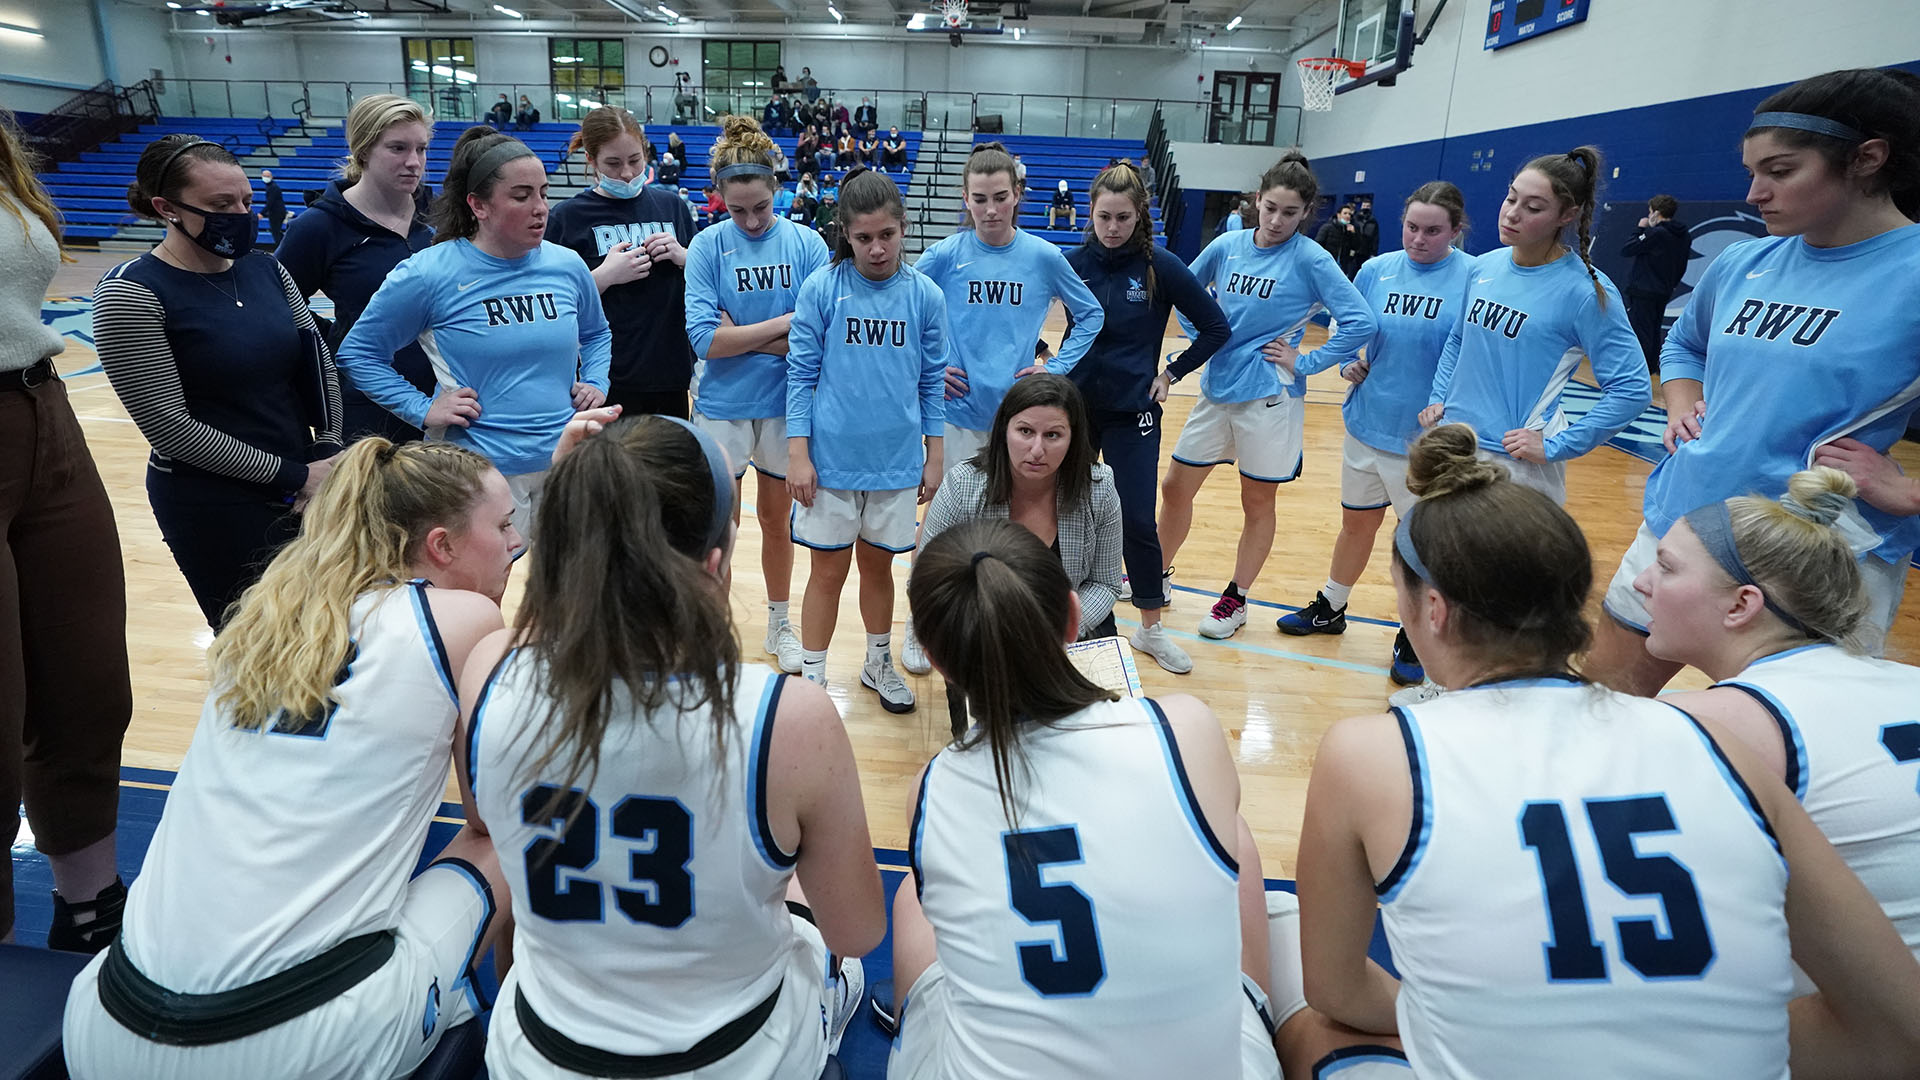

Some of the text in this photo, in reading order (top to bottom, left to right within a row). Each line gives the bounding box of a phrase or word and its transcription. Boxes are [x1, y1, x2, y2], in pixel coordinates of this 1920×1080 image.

[1556, 8, 1575, 23] SCORE
[735, 264, 791, 292] RWU
[967, 280, 1024, 307] RWU
[1226, 272, 1277, 300] RWU
[482, 292, 559, 327] RWU
[1383, 292, 1443, 320] RWU
[1467, 298, 1529, 340] RWU
[845, 317, 907, 348] RWU
[1722, 298, 1842, 347] RWU
[1137, 411, 1153, 427] 20
[520, 782, 696, 930] 23
[1516, 792, 1719, 984] 15
[1000, 823, 1108, 999] 5
